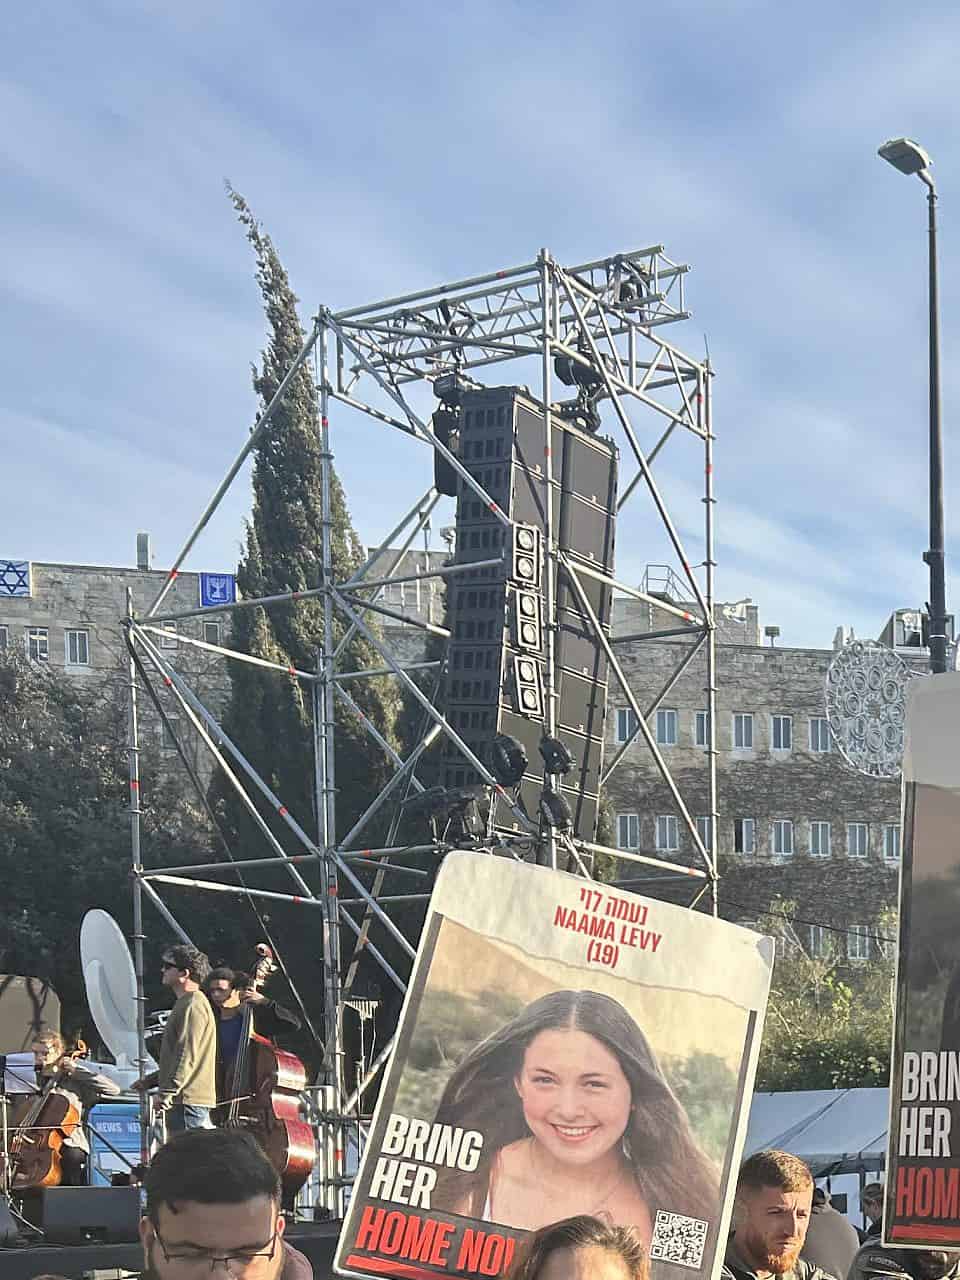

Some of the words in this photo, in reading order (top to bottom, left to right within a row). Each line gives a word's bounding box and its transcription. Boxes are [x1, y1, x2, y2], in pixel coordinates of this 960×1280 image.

[580, 888, 603, 912] לוי
[605, 896, 648, 925] נעמה
[554, 905, 616, 942] NAAMA
[620, 925, 662, 952] LEVY
[587, 939, 619, 968] (19)
[380, 1113, 484, 1172] BRING
[899, 1106, 952, 1158] HER
[368, 1157, 438, 1210] HER
[355, 1206, 456, 1267] HOME
